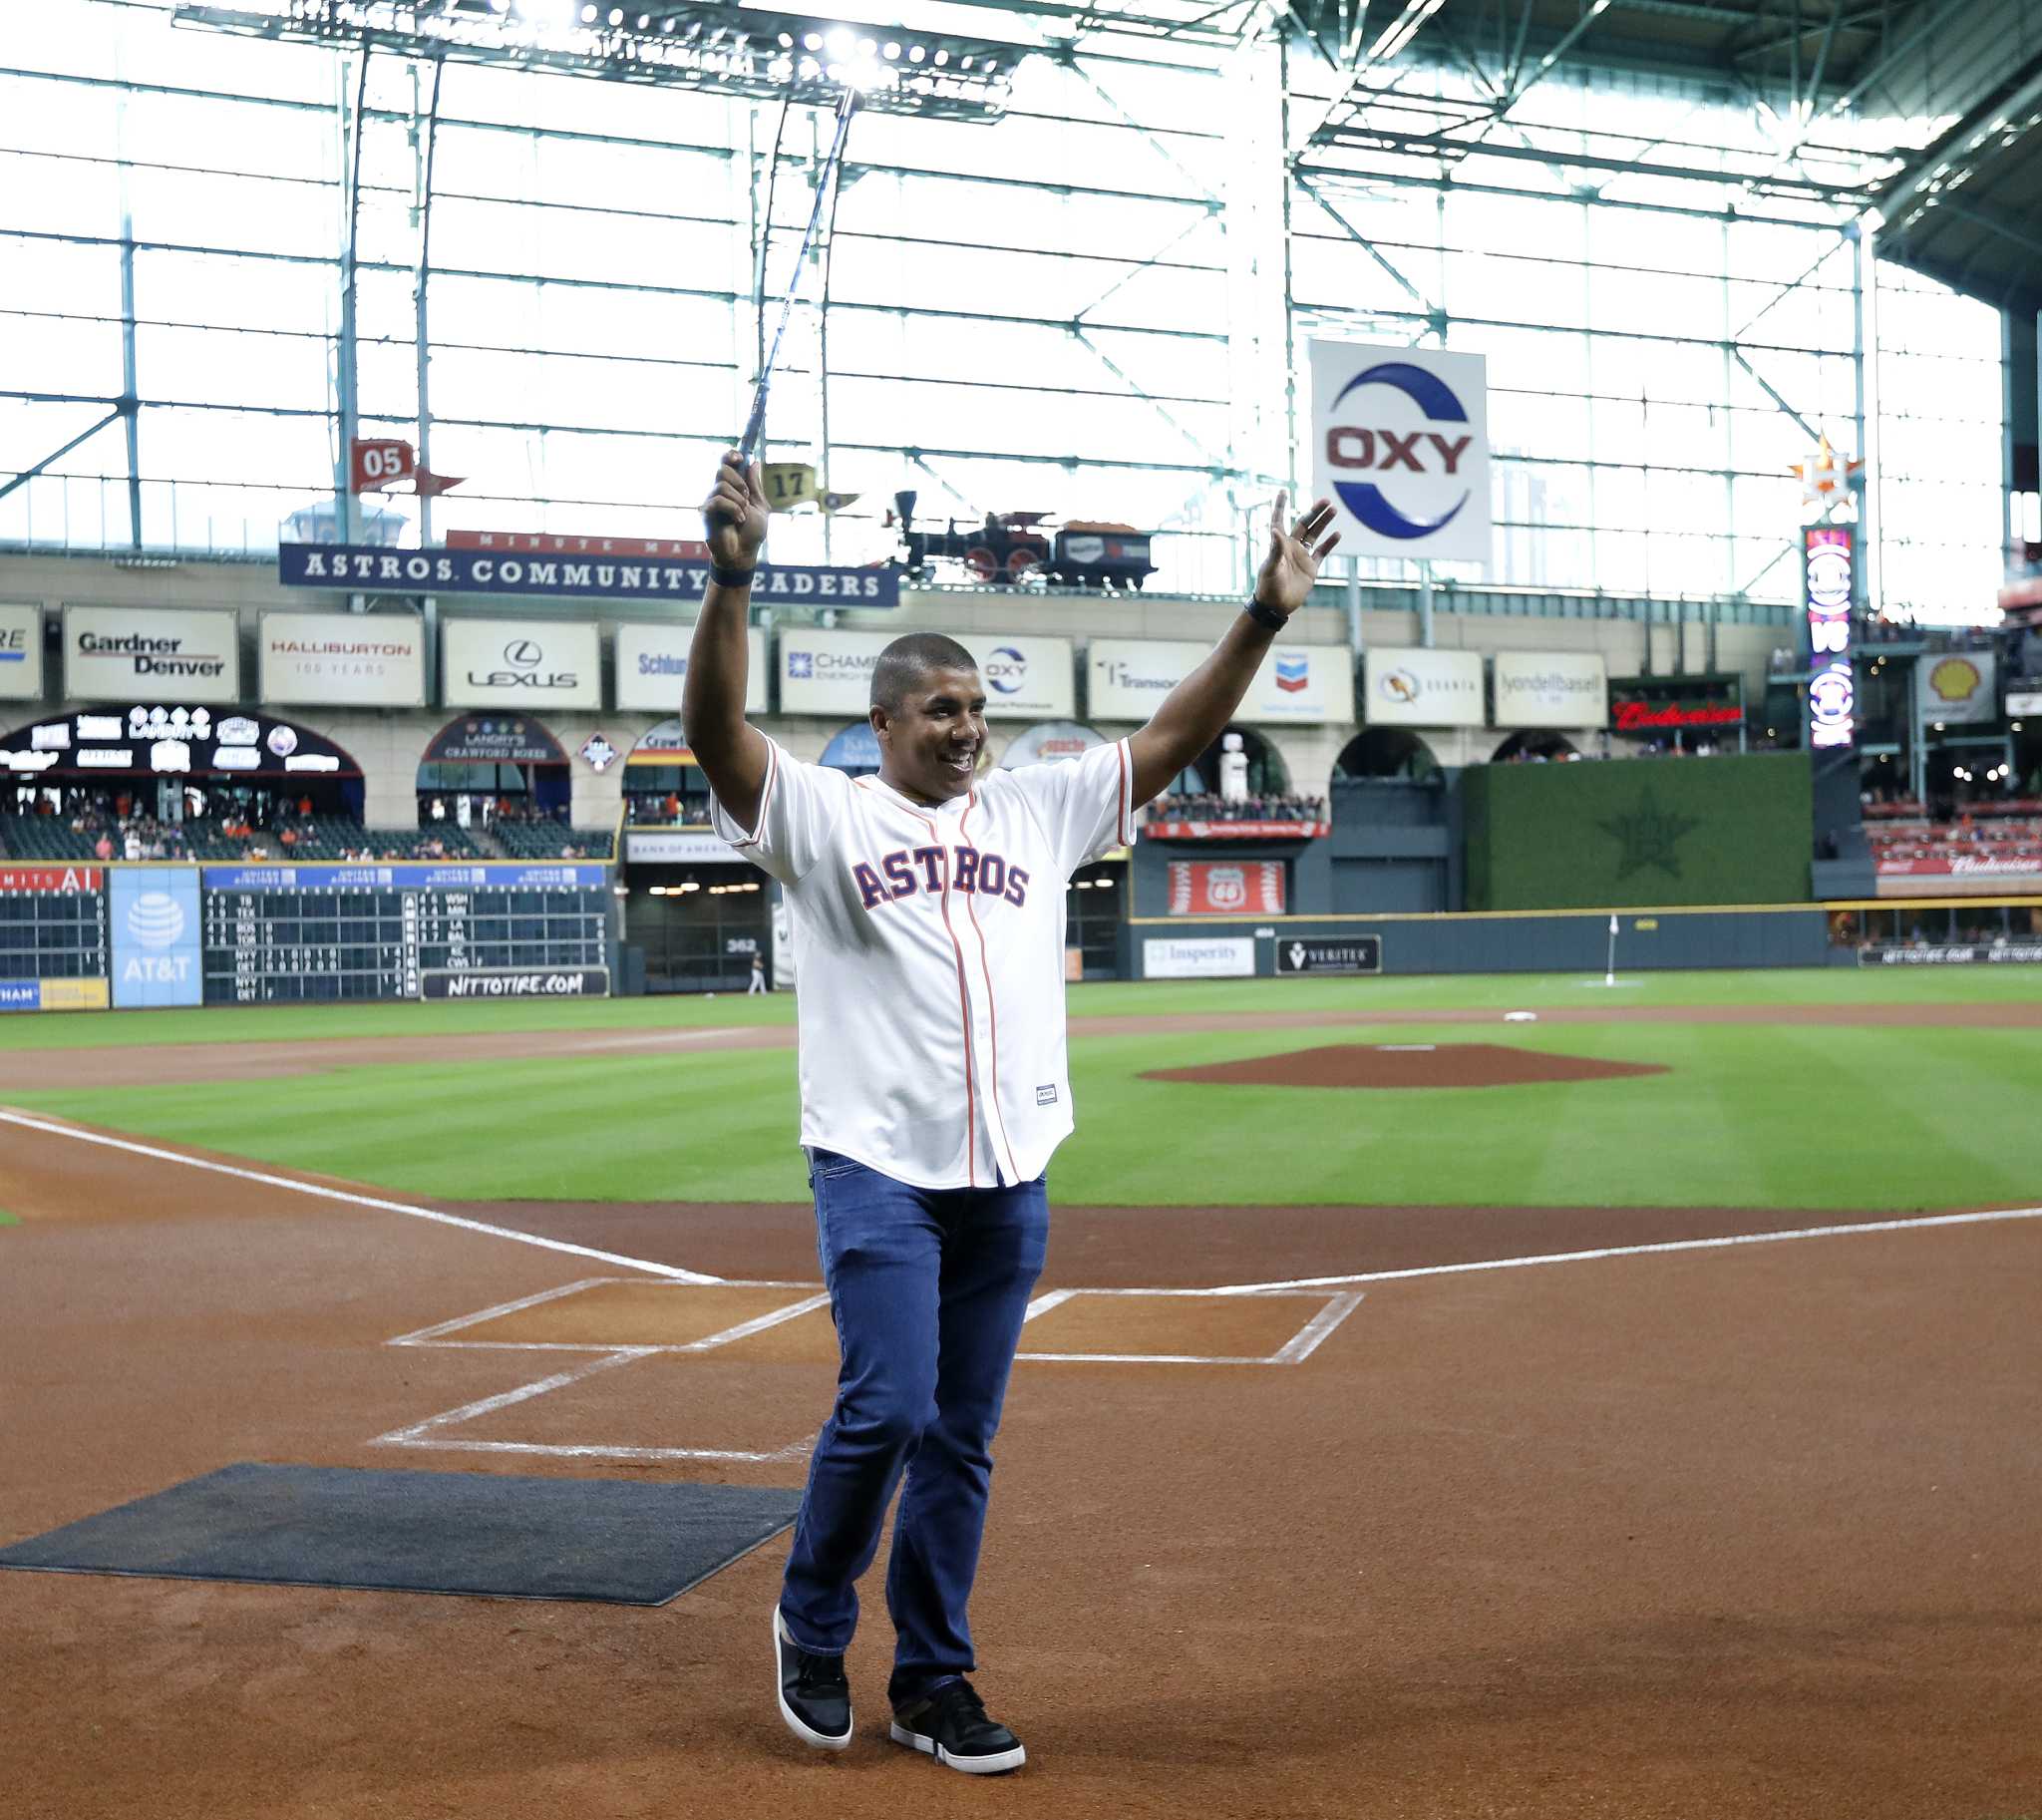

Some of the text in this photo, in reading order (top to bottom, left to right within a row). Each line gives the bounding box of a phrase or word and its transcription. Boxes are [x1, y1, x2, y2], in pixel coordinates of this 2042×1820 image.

[1327, 427, 1473, 475] OXY
[364, 447, 403, 478] 05
[774, 472, 804, 497] 17
[479, 533, 703, 554] MINUTE MAI
[305, 552, 879, 597] ASTROS COMMUNITY EADERS
[79, 632, 181, 653] Gardner
[271, 640, 413, 656] HALLIBURTON
[135, 655, 224, 676] Denver
[816, 652, 877, 667] CHAMP
[985, 662, 1028, 677] OXY
[468, 670, 578, 688] LEXUS
[686, 845, 728, 855] AMERIC
[851, 845, 1030, 910] ASTROS
[124, 955, 191, 982] AT&T
[449, 972, 584, 995] NITTOTIRE.COM
